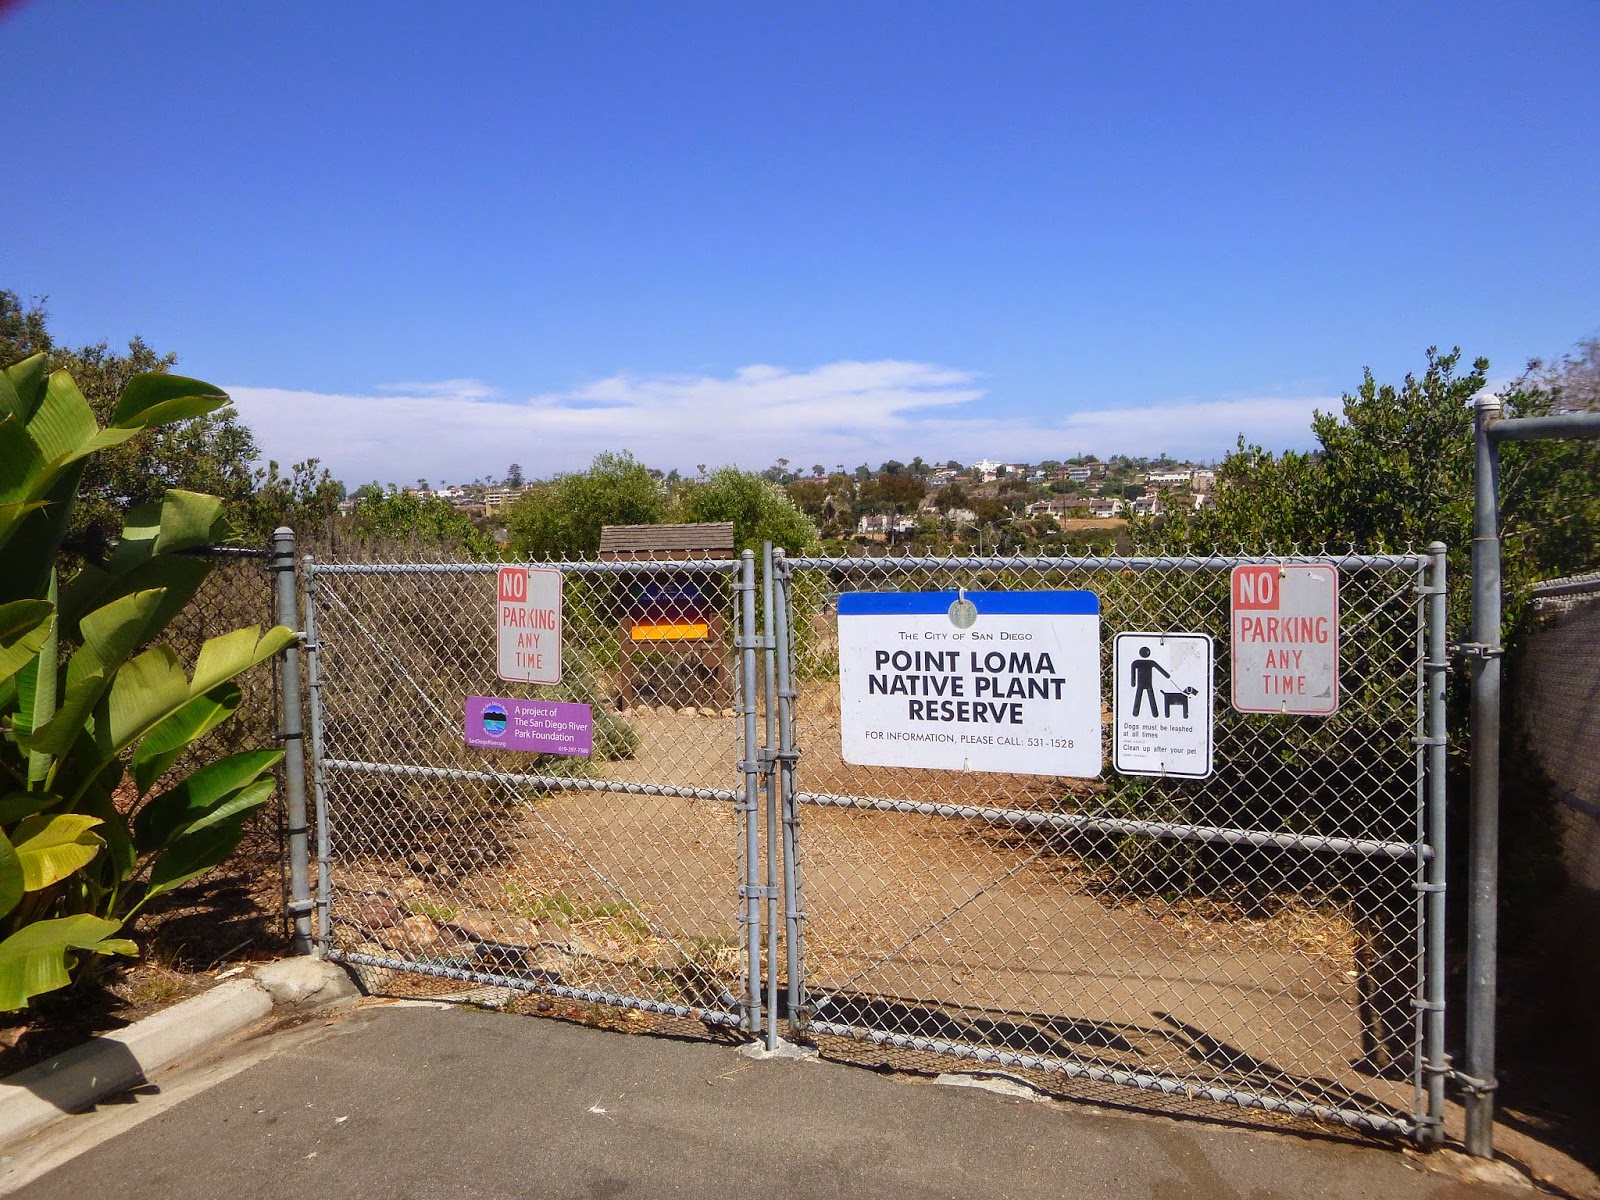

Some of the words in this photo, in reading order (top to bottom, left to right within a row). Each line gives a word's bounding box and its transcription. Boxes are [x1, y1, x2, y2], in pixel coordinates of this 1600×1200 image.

[502, 572, 524, 598] NO
[1240, 572, 1274, 604] NO
[503, 606, 556, 630] PARKING
[517, 632, 540, 648] ANY
[1241, 616, 1328, 644] PARKING
[516, 652, 542, 669] TIME
[875, 650, 960, 673] POINT
[971, 651, 1056, 674] LOMA
[1265, 649, 1303, 670] ANY
[868, 674, 964, 697] NATIVE
[975, 677, 1066, 700] PLANT
[1262, 675, 1306, 695] TIME
[521, 707, 548, 717] project
[549, 708, 558, 716] of
[909, 700, 1023, 724] RESERVE
[514, 718, 528, 726] The
[530, 719, 543, 727] San
[545, 720, 567, 731] Diego
[569, 722, 588, 731] River
[1124, 723, 1139, 731] Dogs
[514, 730, 530, 738] Park
[532, 731, 574, 742] Foundation
[865, 731, 884, 740] FOR
[887, 732, 957, 744] INFORMATION,
[960, 735, 994, 745] PLEASE
[997, 736, 1024, 746] CALL:
[1027, 738, 1074, 749] 531-1528
